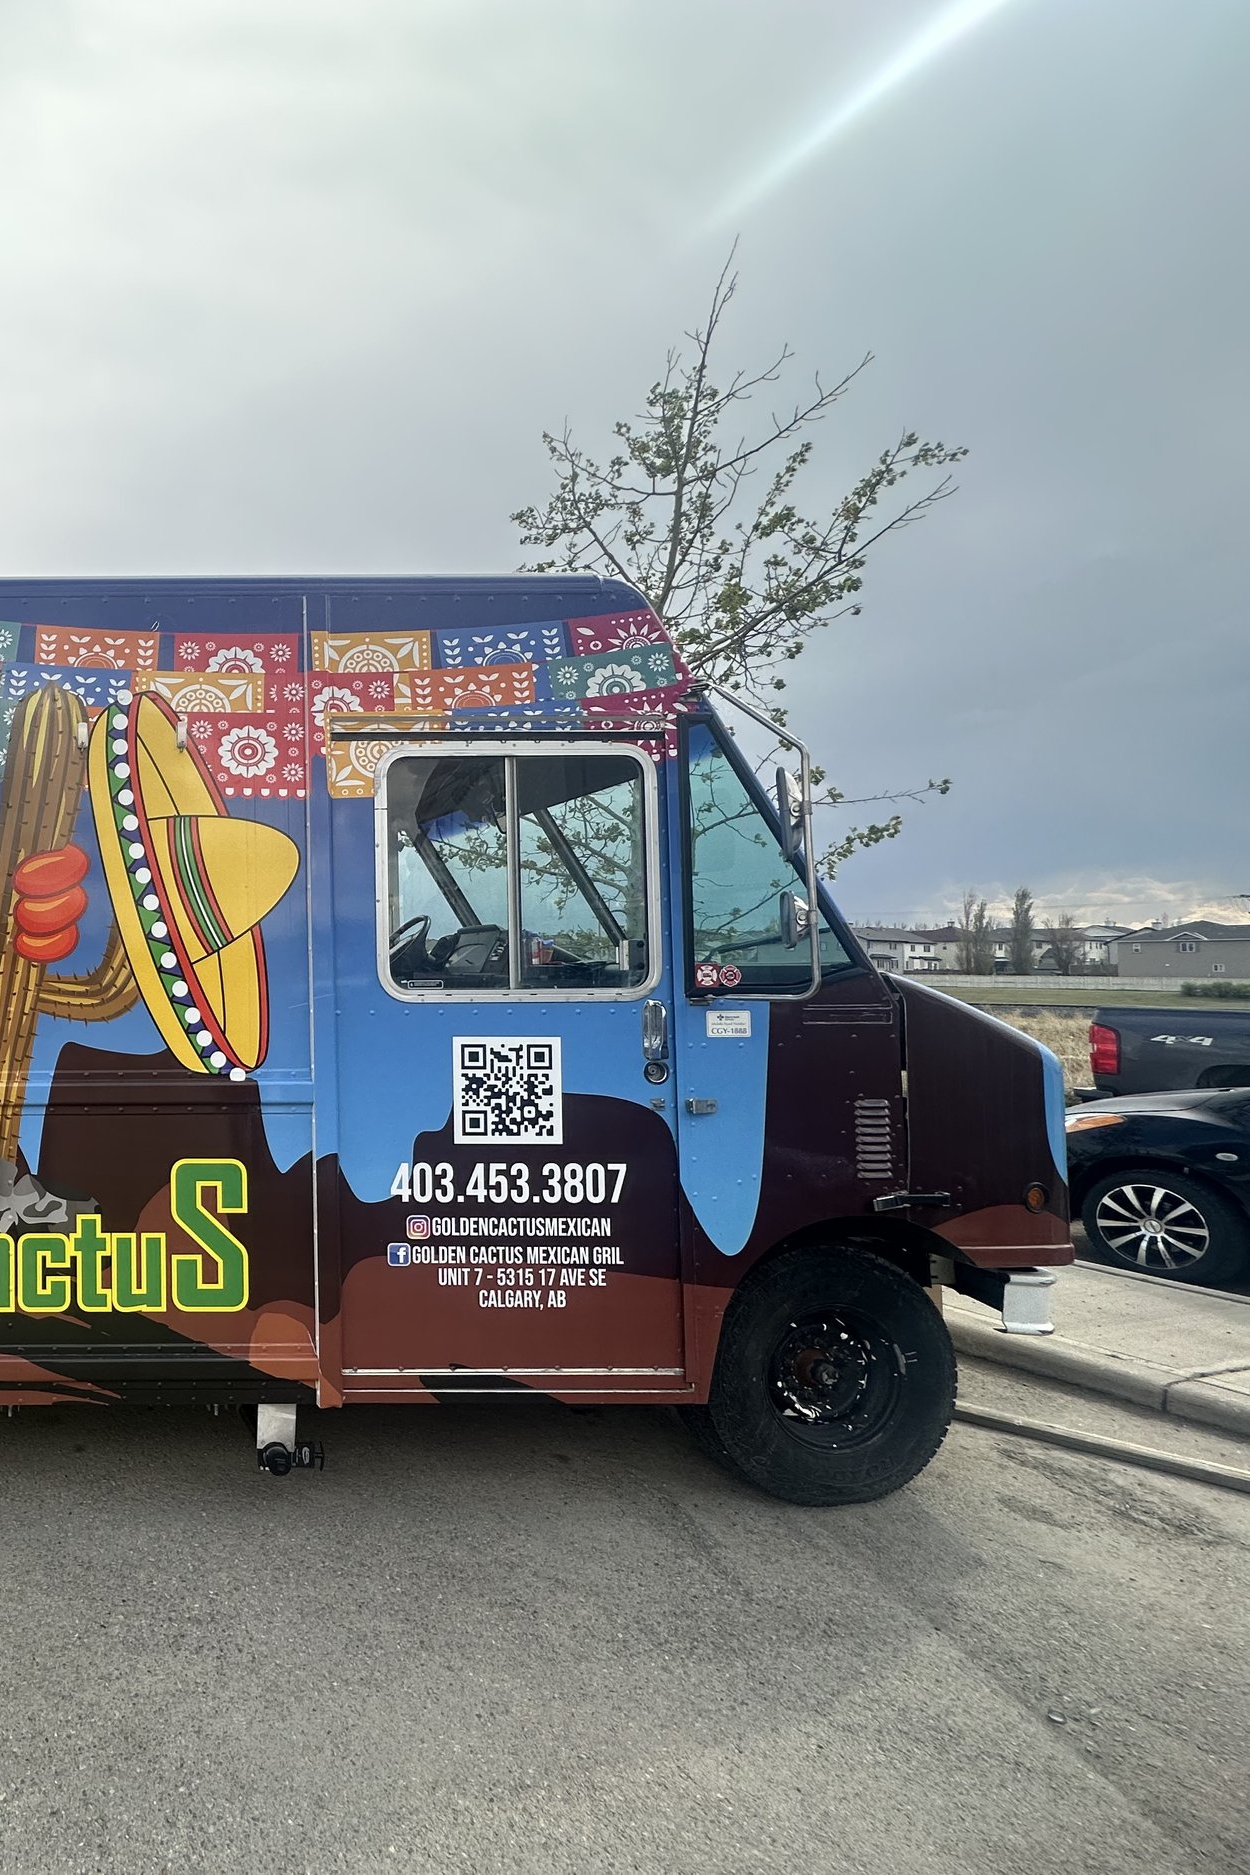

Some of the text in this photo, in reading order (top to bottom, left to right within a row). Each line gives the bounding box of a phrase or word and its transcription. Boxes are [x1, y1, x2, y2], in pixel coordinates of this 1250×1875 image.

[390, 1162, 628, 1204] 403.453.3807
[431, 1216, 611, 1238] GOLDENCACTUSMEXICAN
[412, 1245, 625, 1266] GOLDEN CACTUS MEXICAN GRIL
[438, 1267, 471, 1287] UNIT
[474, 1268, 483, 1286] 7
[496, 1267, 535, 1287] 5315
[538, 1268, 556, 1286] 17
[559, 1268, 587, 1287] AVE
[588, 1268, 607, 1287] SE
[478, 1289, 567, 1311] CALGARY, AB
